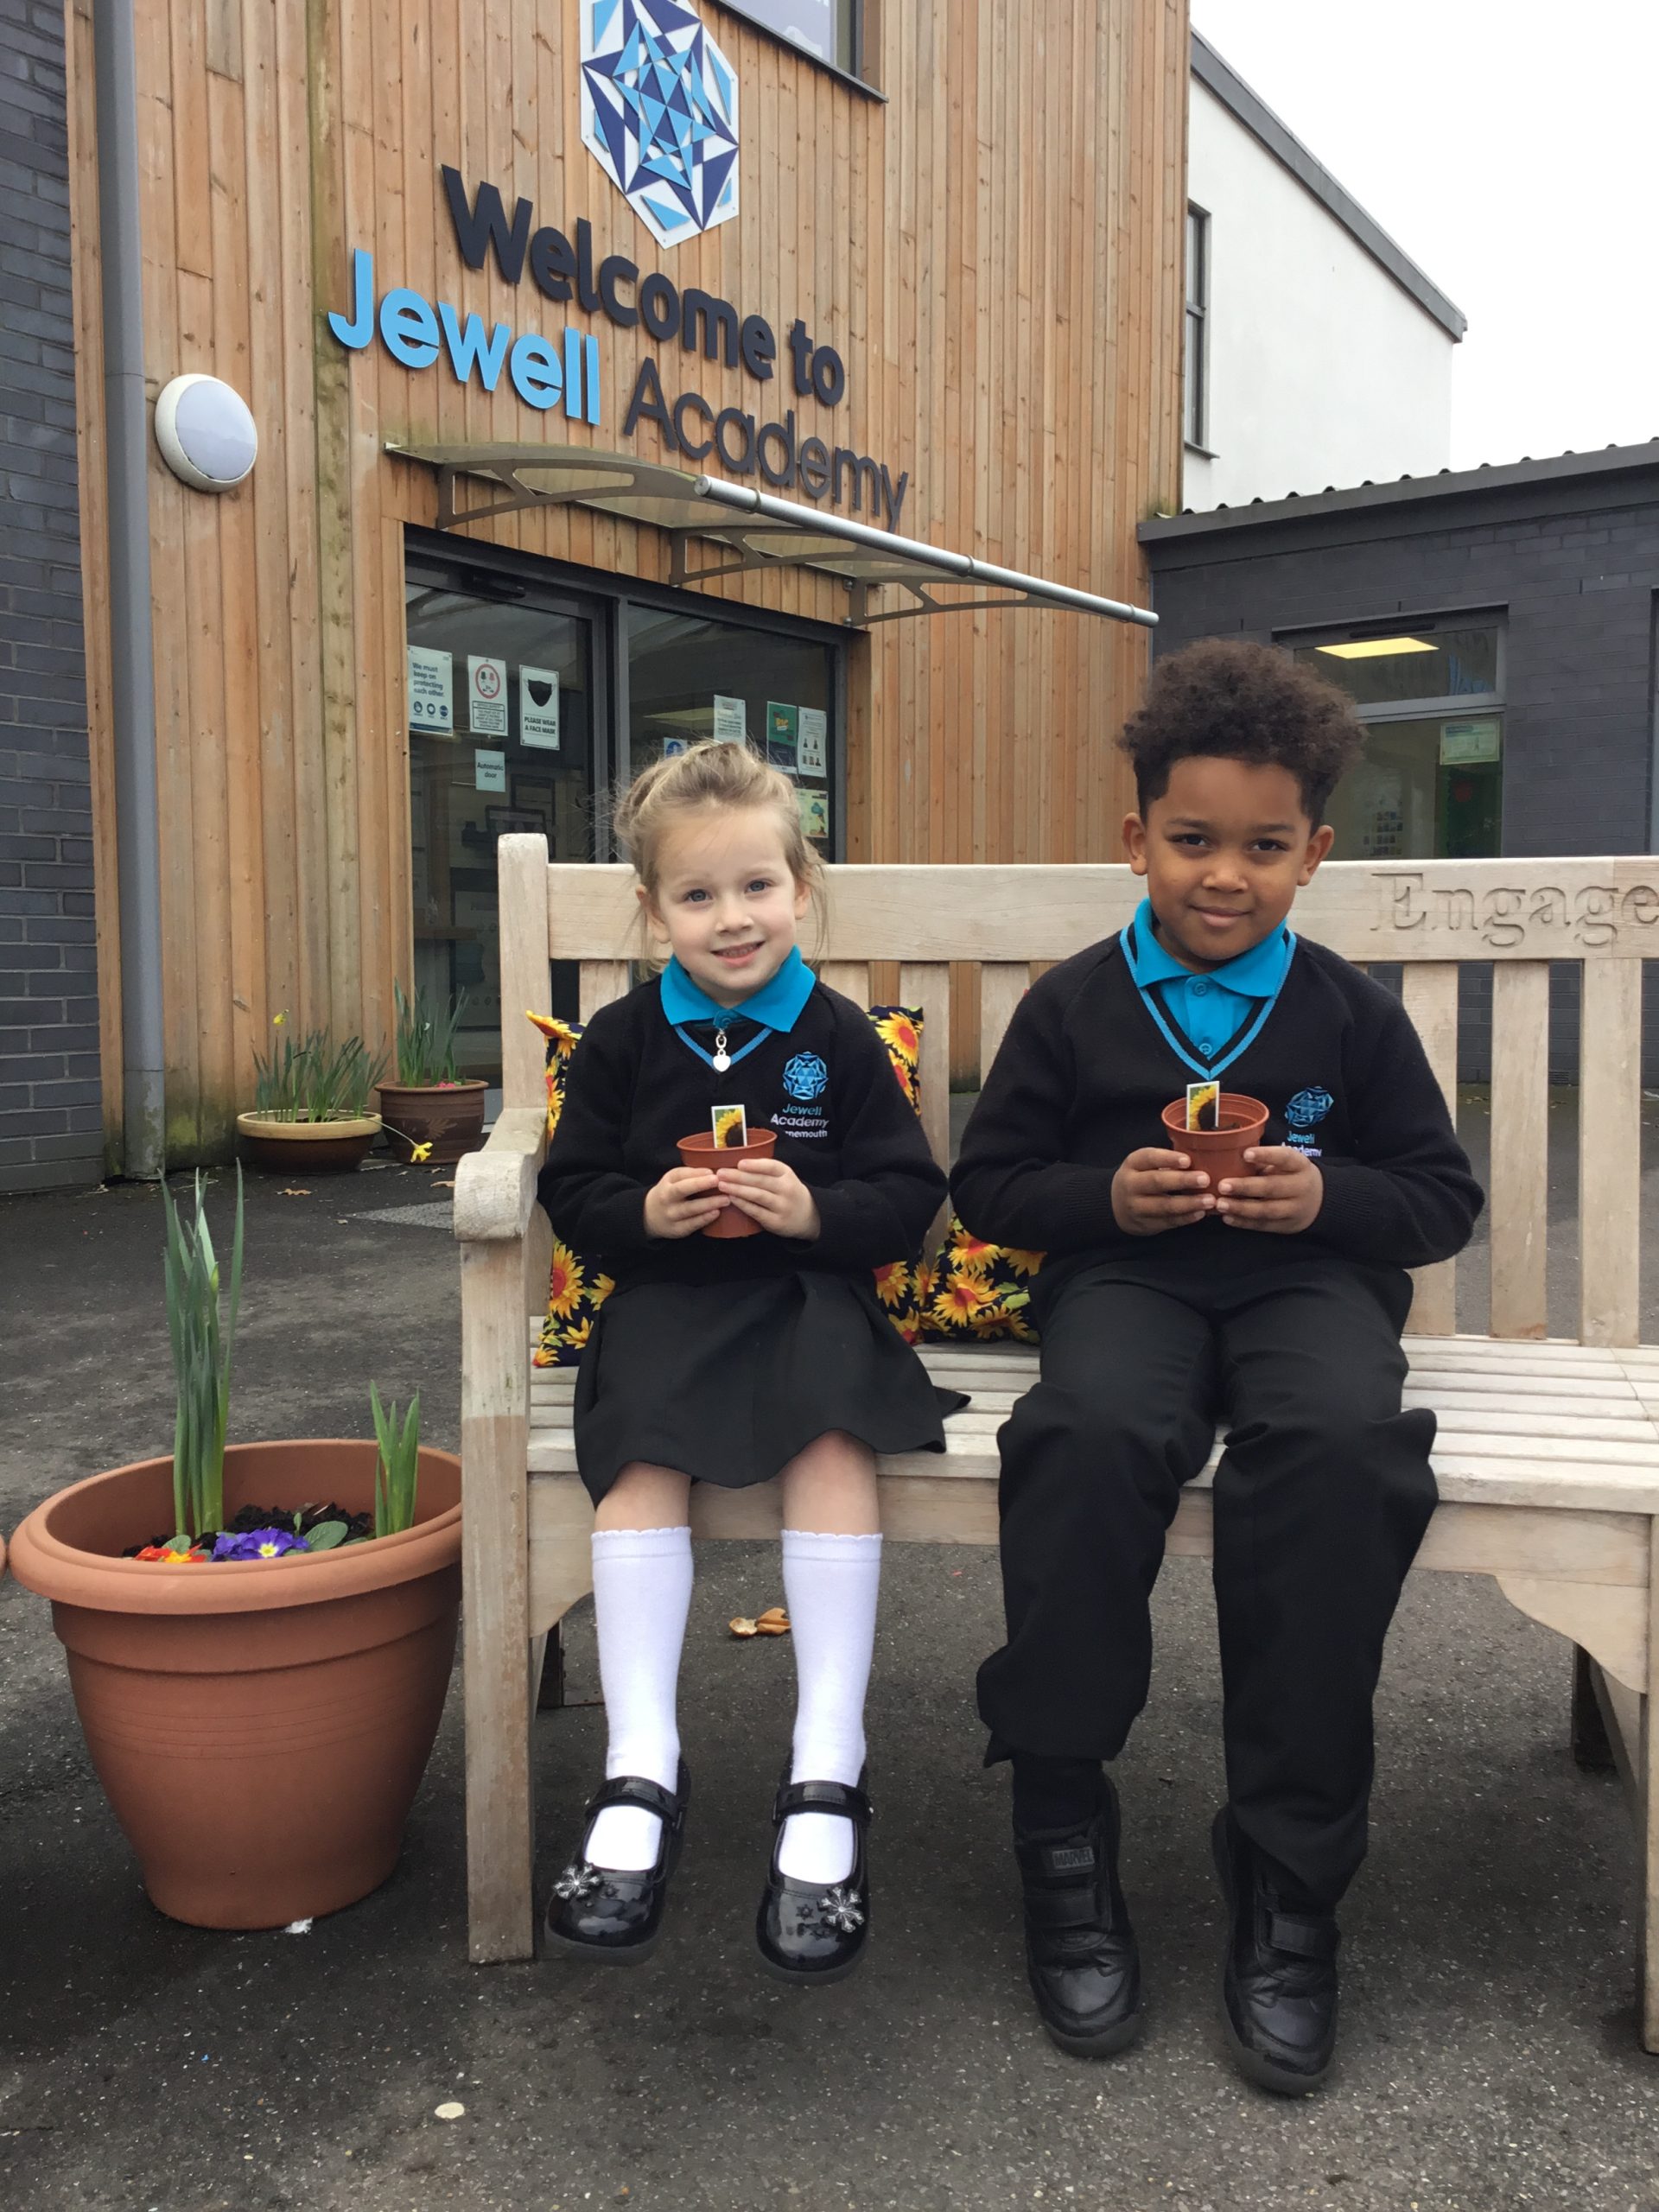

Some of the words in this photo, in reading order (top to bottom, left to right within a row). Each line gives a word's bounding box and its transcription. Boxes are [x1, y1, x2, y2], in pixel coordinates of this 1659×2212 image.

[442, 164, 776, 379] Welcome
[791, 318, 844, 406] to
[328, 249, 601, 425] Jewell
[624, 358, 908, 534] Academy
[477, 762, 504, 771] Automatic
[1370, 873, 1659, 946] Engage
[782, 1103, 822, 1116] Jewell
[771, 1113, 830, 1128] Academy
[785, 1129, 828, 1138] nemouth
[1287, 1131, 1314, 1144] Jewell
[1054, 1850, 1092, 1866] MARVEL
